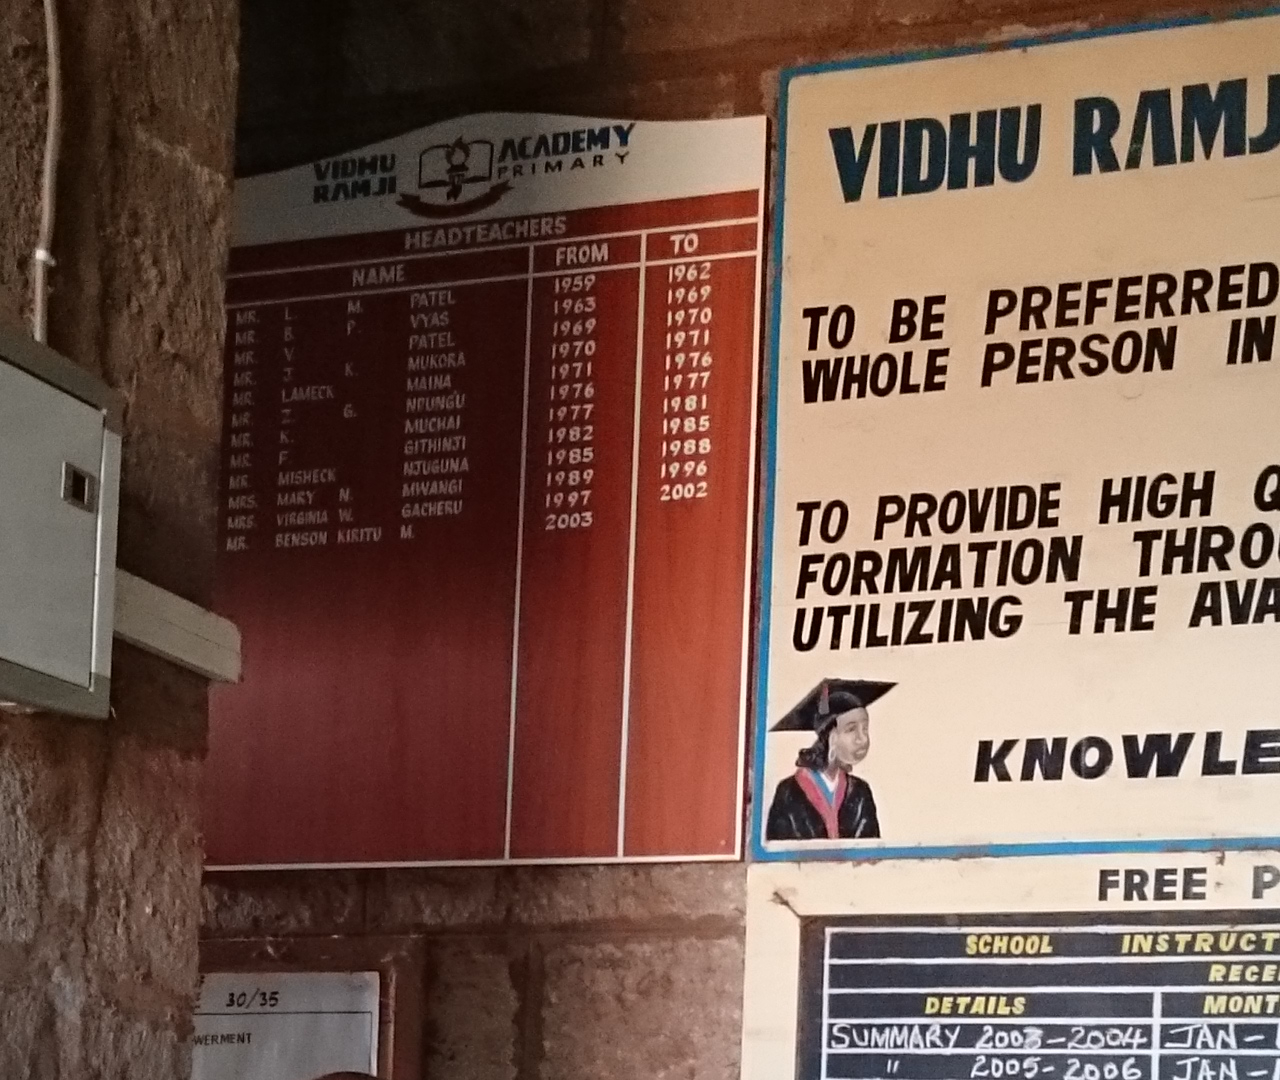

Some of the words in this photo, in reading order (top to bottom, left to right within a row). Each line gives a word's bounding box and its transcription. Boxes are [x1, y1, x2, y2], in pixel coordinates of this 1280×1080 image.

[498, 124, 636, 162] ACADEMY
[828, 104, 1040, 203] VIDHU
[498, 151, 630, 180] PRIMARY
[312, 176, 397, 204] RAMJI
[405, 216, 567, 250] HEADTEACHERS
[352, 265, 405, 287] NAME
[555, 243, 609, 266] FROM
[670, 234, 699, 255] TO
[410, 290, 455, 309] PATEL
[554, 274, 596, 294] 1959
[669, 262, 711, 282] 1962
[411, 312, 449, 328] VYAS
[554, 297, 596, 314] 1963
[668, 285, 711, 304] 1969
[803, 305, 855, 351] TO
[889, 295, 947, 344] BE
[984, 262, 1280, 335] PREFERRED
[409, 332, 455, 350] PATEL
[552, 319, 596, 337] 1969
[667, 308, 712, 327] 1970
[408, 352, 465, 371] MUKORA
[552, 341, 596, 359] 1970
[666, 330, 710, 349] 1971
[802, 349, 950, 404] WHOLE
[979, 327, 1177, 387] PERSON
[1227, 318, 1275, 365] IN
[406, 374, 451, 391] MAINA
[551, 362, 592, 380] 1971
[666, 352, 712, 370] 1976
[550, 383, 594, 400] 1976
[664, 372, 711, 390] 1977
[405, 415, 460, 433] MUCHAI
[549, 404, 594, 422] 1977
[663, 394, 707, 414] 1981
[404, 436, 466, 455] GITHINJI
[548, 426, 593, 444] 1982
[662, 416, 710, 434] 1985
[404, 457, 469, 476] NJUGUNA
[548, 448, 594, 466] 1985
[662, 438, 711, 458] 1988
[402, 478, 462, 497] MWANGI
[547, 469, 594, 487] 1989
[660, 460, 707, 478] 1996
[401, 500, 462, 518] GACHERU
[660, 482, 708, 500] 2002
[796, 499, 848, 546] TO
[875, 482, 1060, 542] PROVIDE
[1099, 470, 1214, 525] HIGH
[545, 511, 593, 530] 2003
[795, 535, 1082, 600] FORMATION
[792, 598, 1024, 651] UTILIZING
[1063, 587, 1159, 636] THE
[1098, 867, 1209, 902] FREE
[966, 934, 1054, 955] SCHOOL
[225, 989, 280, 1009] 30/35
[925, 996, 1026, 1014] DETAILS
[831, 1024, 961, 1049] SUMMARY
